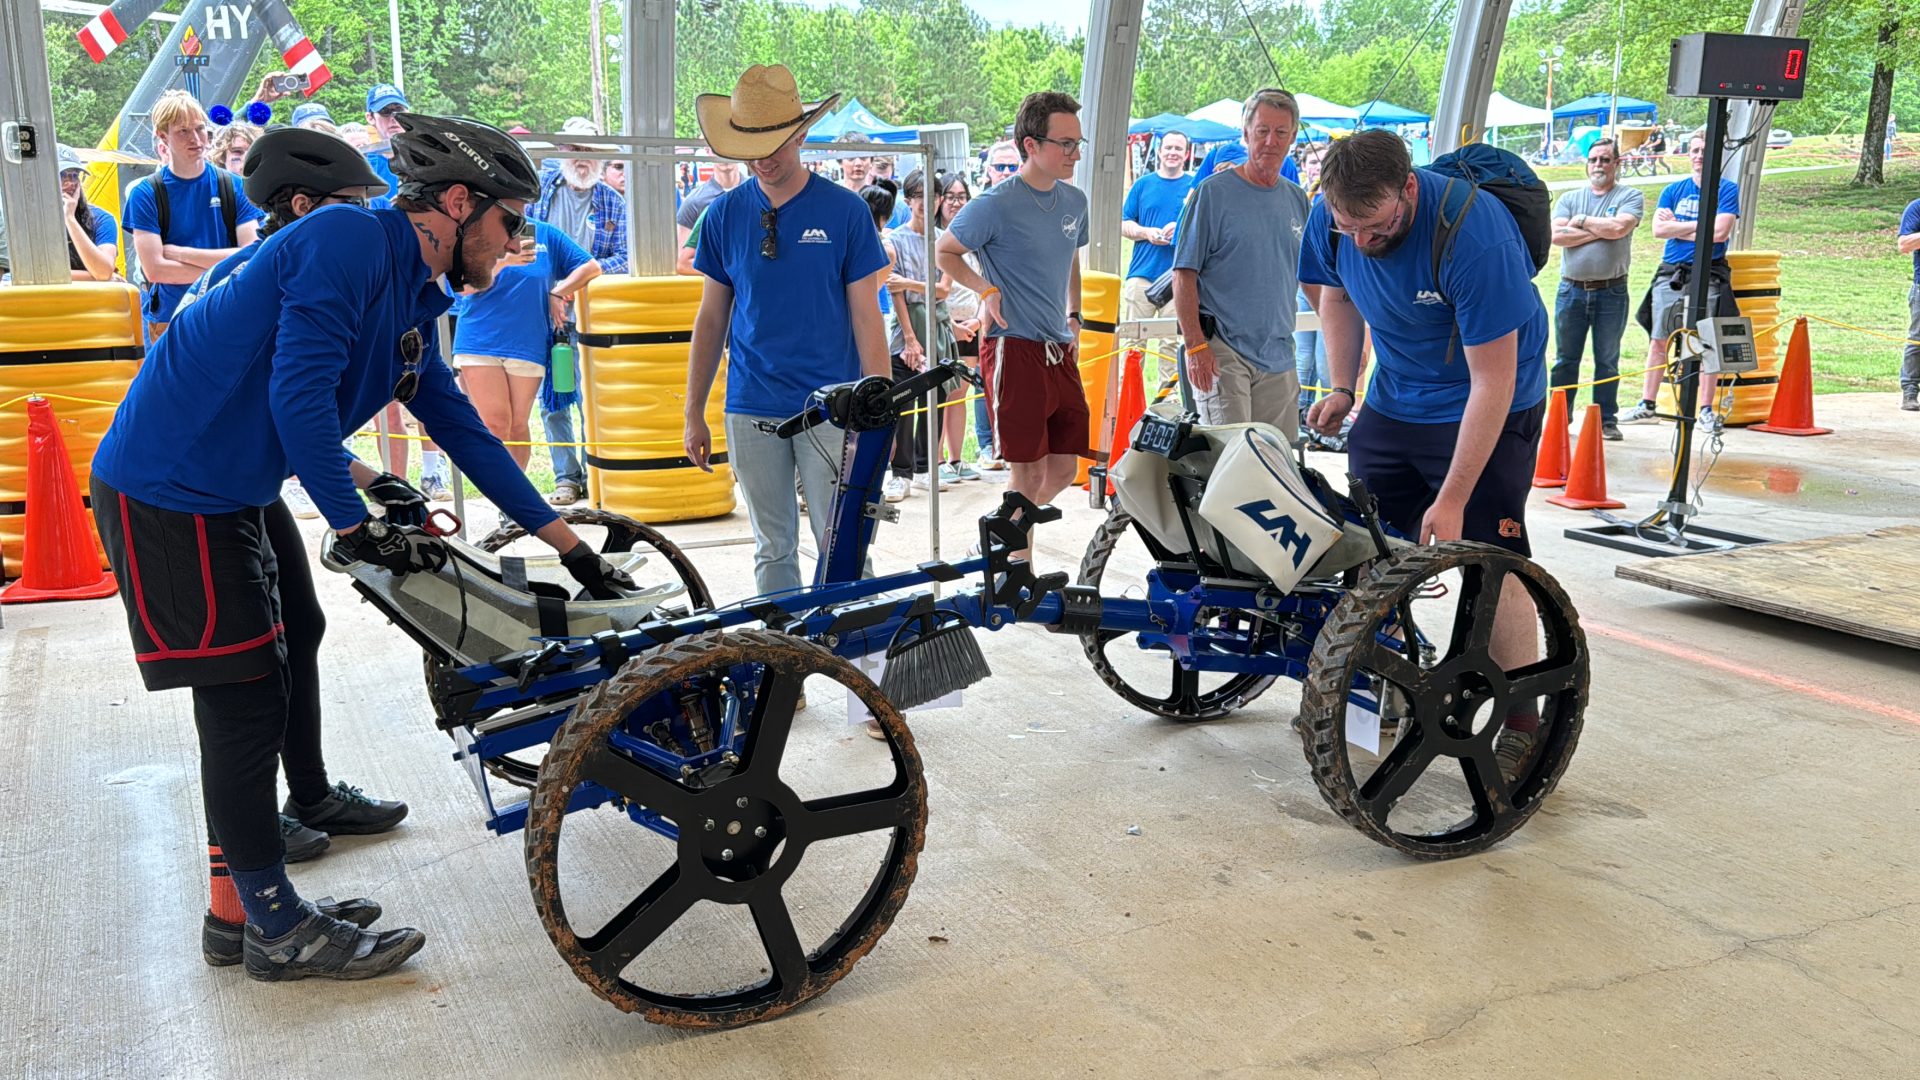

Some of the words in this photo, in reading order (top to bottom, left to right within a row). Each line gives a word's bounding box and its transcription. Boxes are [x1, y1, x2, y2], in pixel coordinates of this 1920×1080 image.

[205, 4, 252, 40] HY
[1785, 49, 1803, 79] 0
[458, 141, 490, 171] GIRO
[1140, 422, 1176, 451] 8:00
